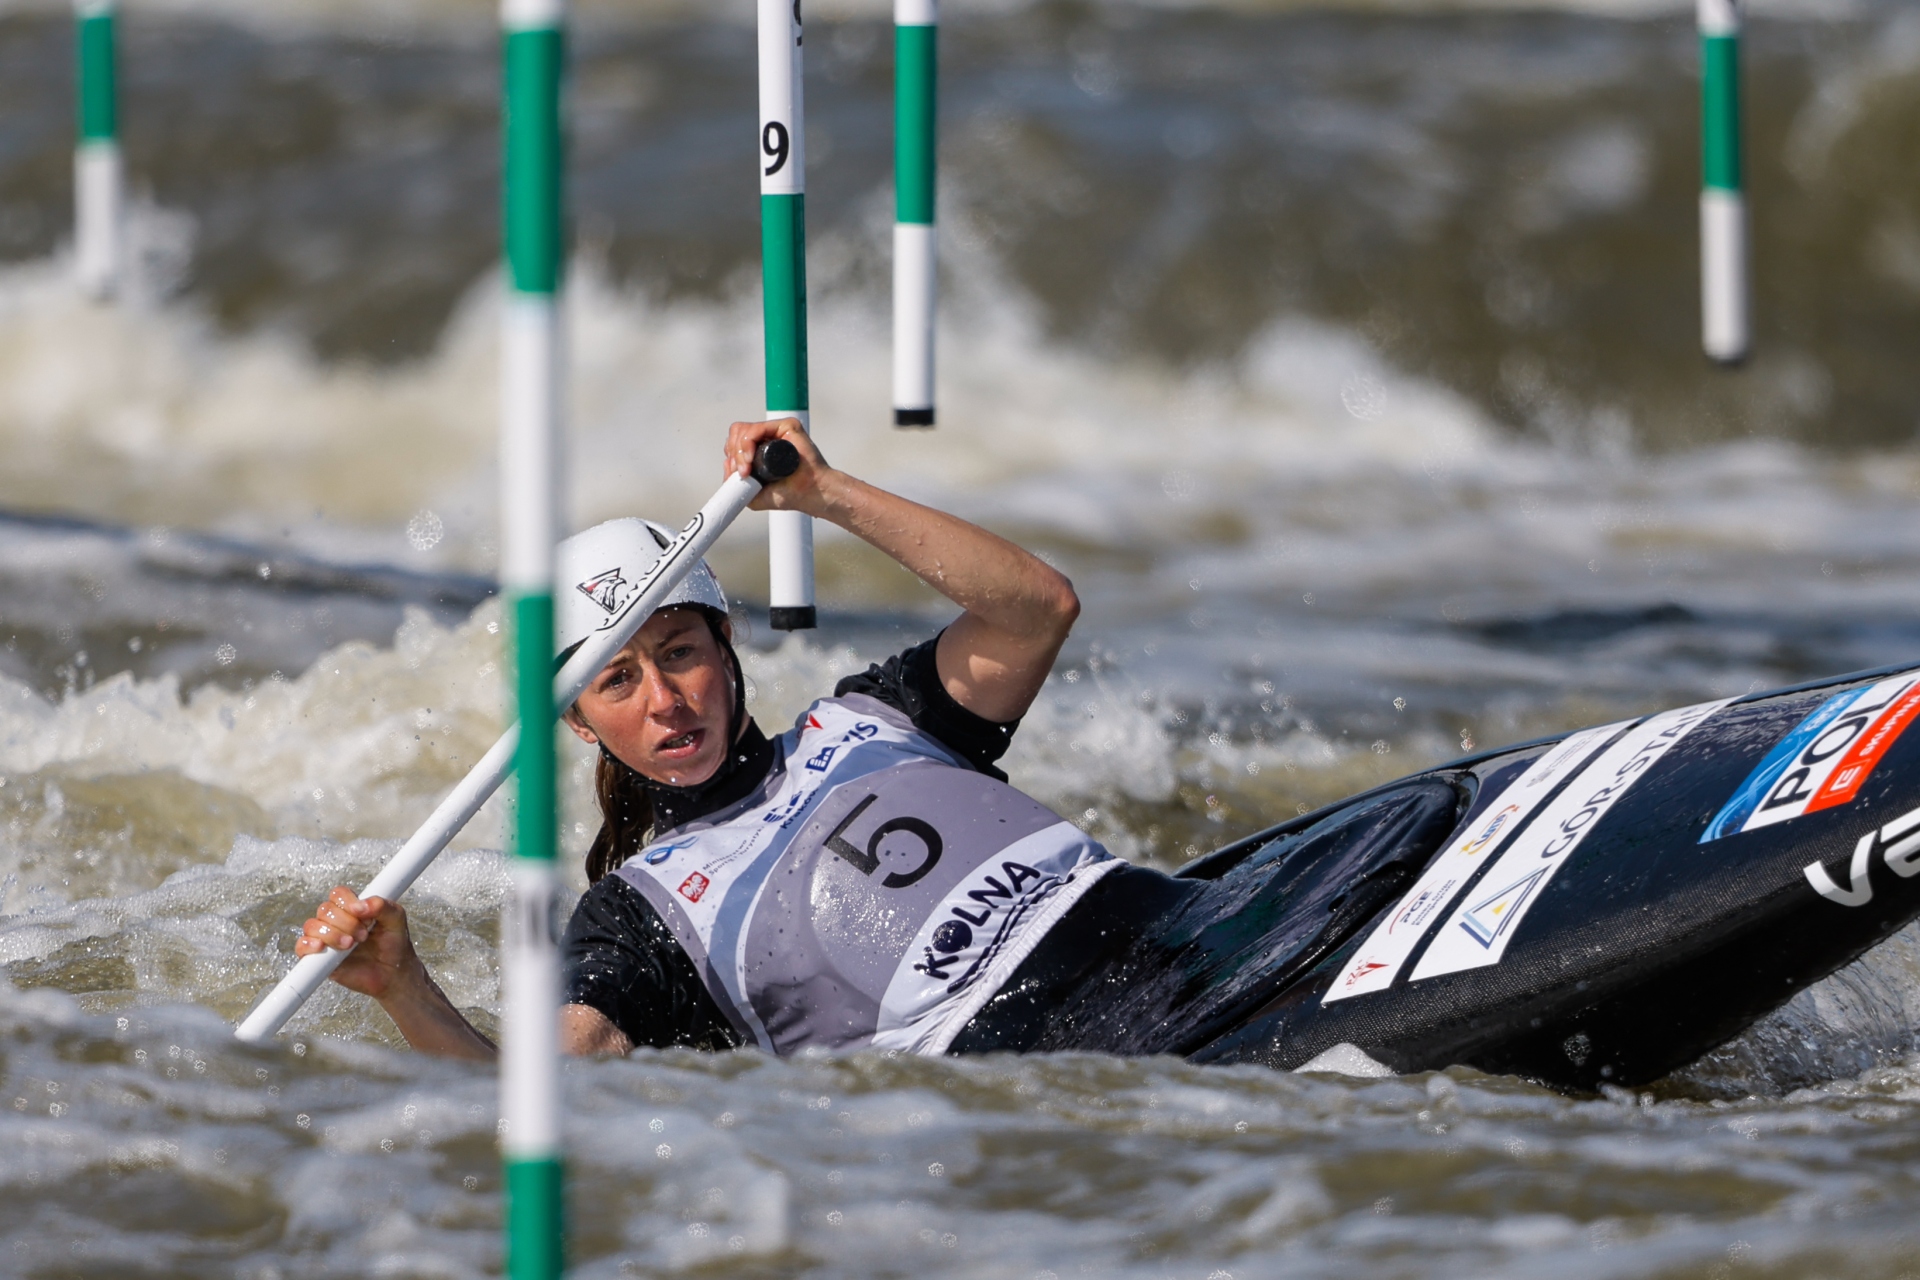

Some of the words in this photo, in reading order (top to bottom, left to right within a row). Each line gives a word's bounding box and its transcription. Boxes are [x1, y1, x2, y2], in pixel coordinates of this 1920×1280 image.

[762, 121, 789, 176] 9
[1758, 679, 1917, 813] POL
[824, 793, 943, 888] 5
[913, 861, 1041, 980] KOLNA
[1400, 891, 1432, 923] PGE
